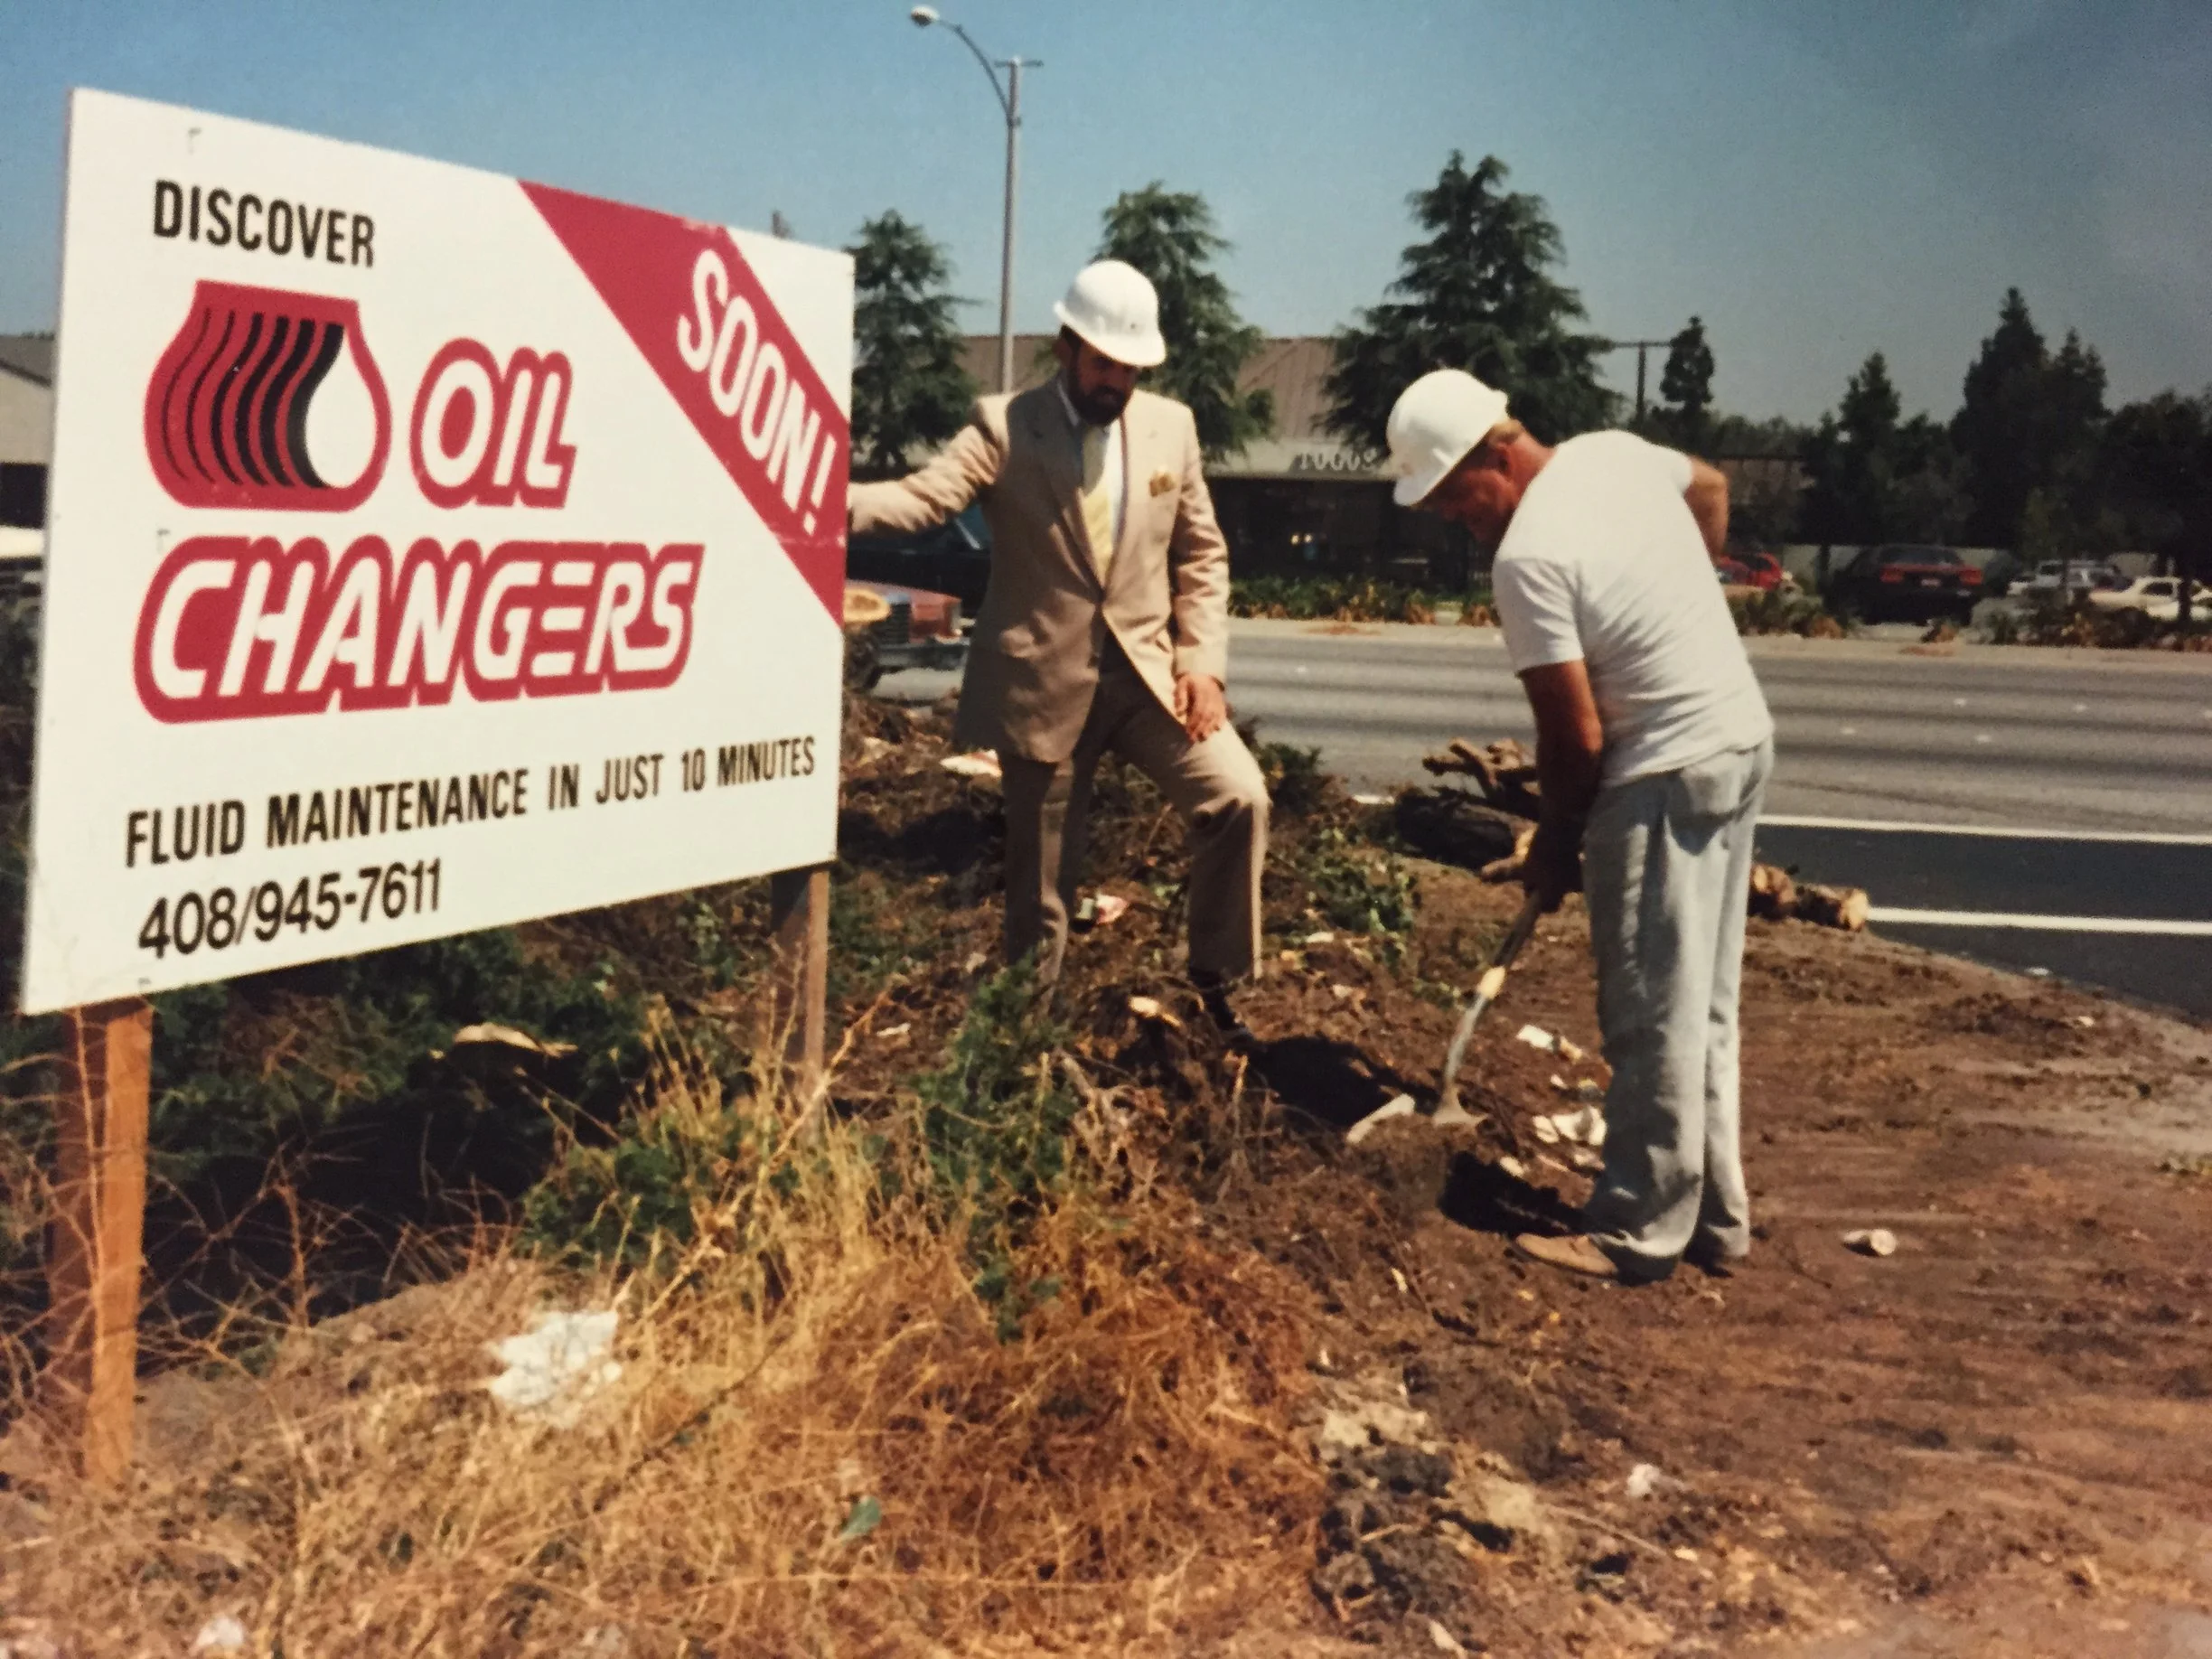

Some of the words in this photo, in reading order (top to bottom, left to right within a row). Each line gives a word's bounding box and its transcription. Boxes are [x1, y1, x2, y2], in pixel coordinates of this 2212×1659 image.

[154, 180, 375, 267] DISCOVER
[420, 357, 568, 491] OIL
[677, 249, 837, 534] SOON!
[150, 555, 694, 698] CHANGERS
[126, 801, 245, 868] FLUID
[267, 769, 529, 848] MAINTENANCE
[548, 764, 579, 810] IN
[595, 754, 661, 804] JUST
[680, 749, 706, 793] 10
[717, 736, 816, 787] MINUTES
[138, 858, 443, 960] 408/945-7611
